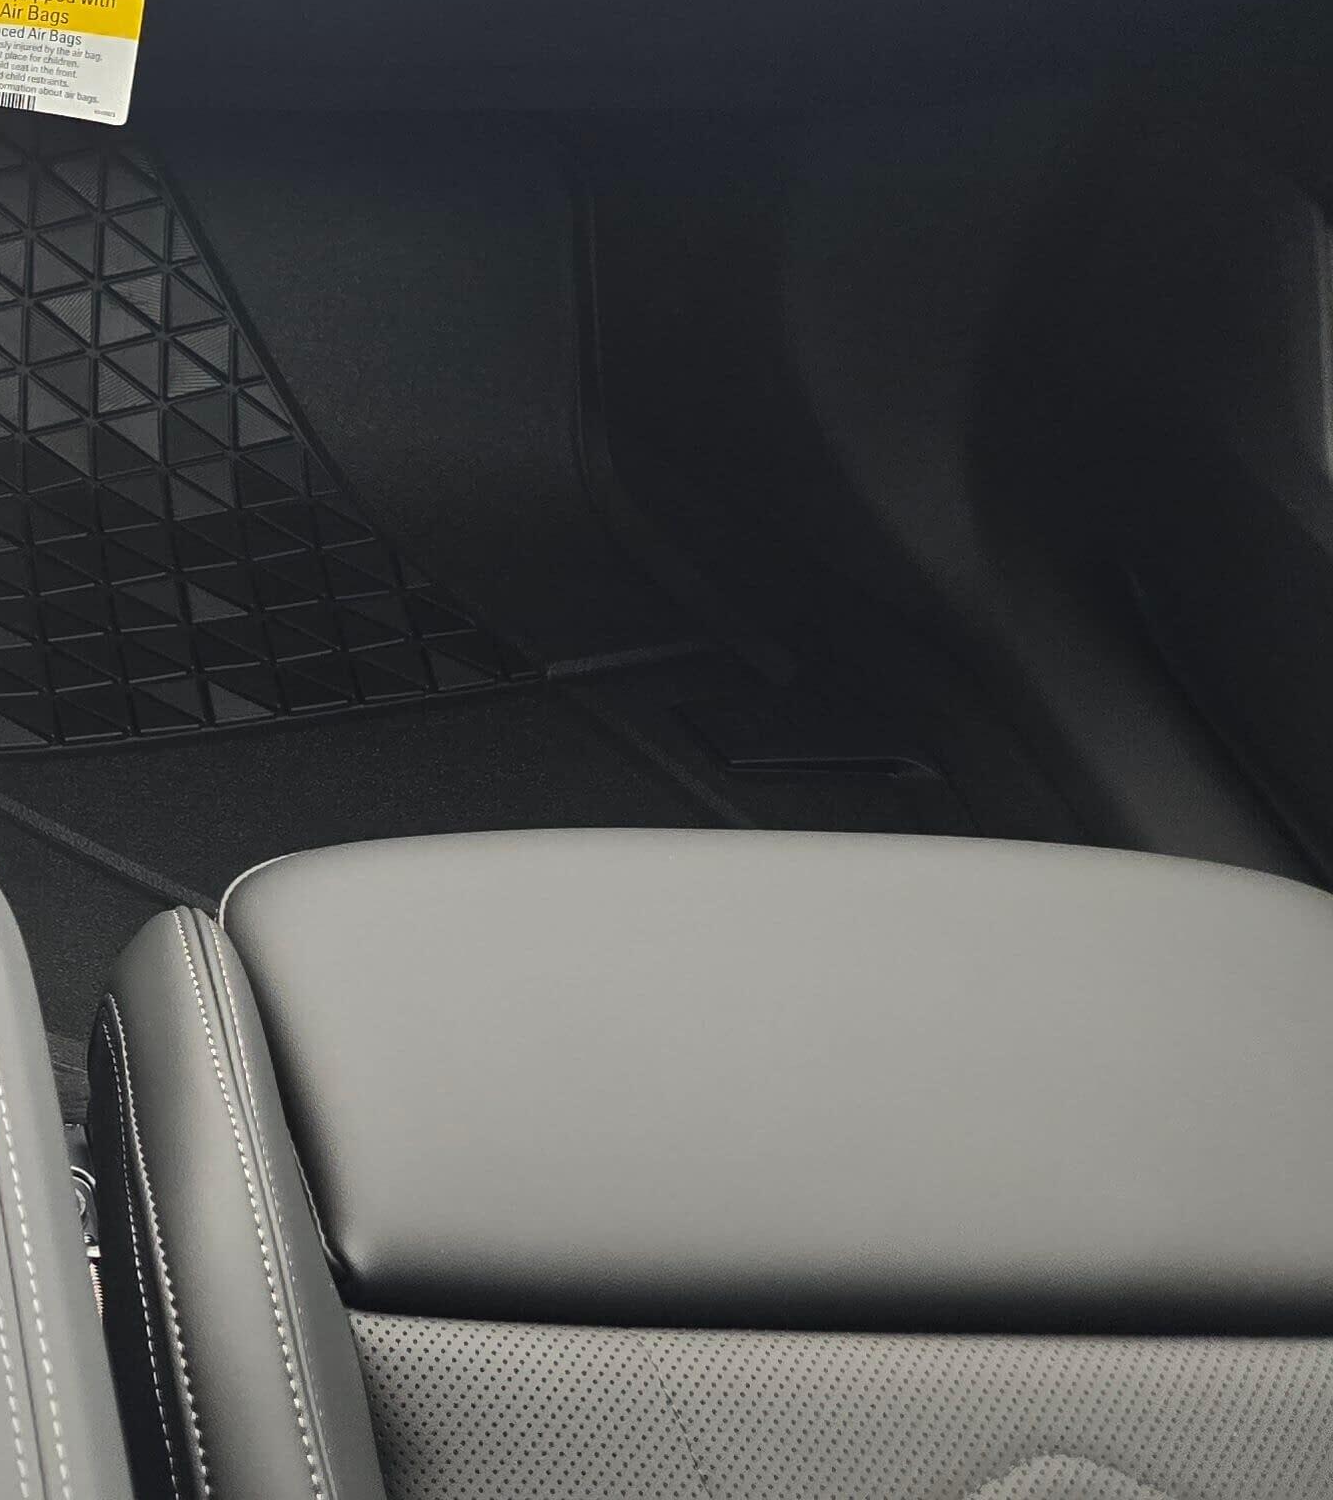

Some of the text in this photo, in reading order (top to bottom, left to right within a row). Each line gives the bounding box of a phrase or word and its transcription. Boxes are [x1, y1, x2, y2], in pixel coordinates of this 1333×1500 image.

[0, 3, 23, 19] Air
[28, 5, 69, 26] Bags
[27, 28, 46, 40] Air
[50, 30, 82, 47] Bags
[5, 51, 27, 61] place
[30, 53, 41, 61] for
[43, 55, 79, 68] children.
[13, 42, 42, 52] injured
[44, 45, 55, 55] by
[56, 47, 70, 56] the
[72, 49, 83, 57] air
[85, 49, 102, 62] bag.
[11, 63, 29, 71] seat
[40, 65, 53, 74] the
[56, 66, 77, 78] front.
